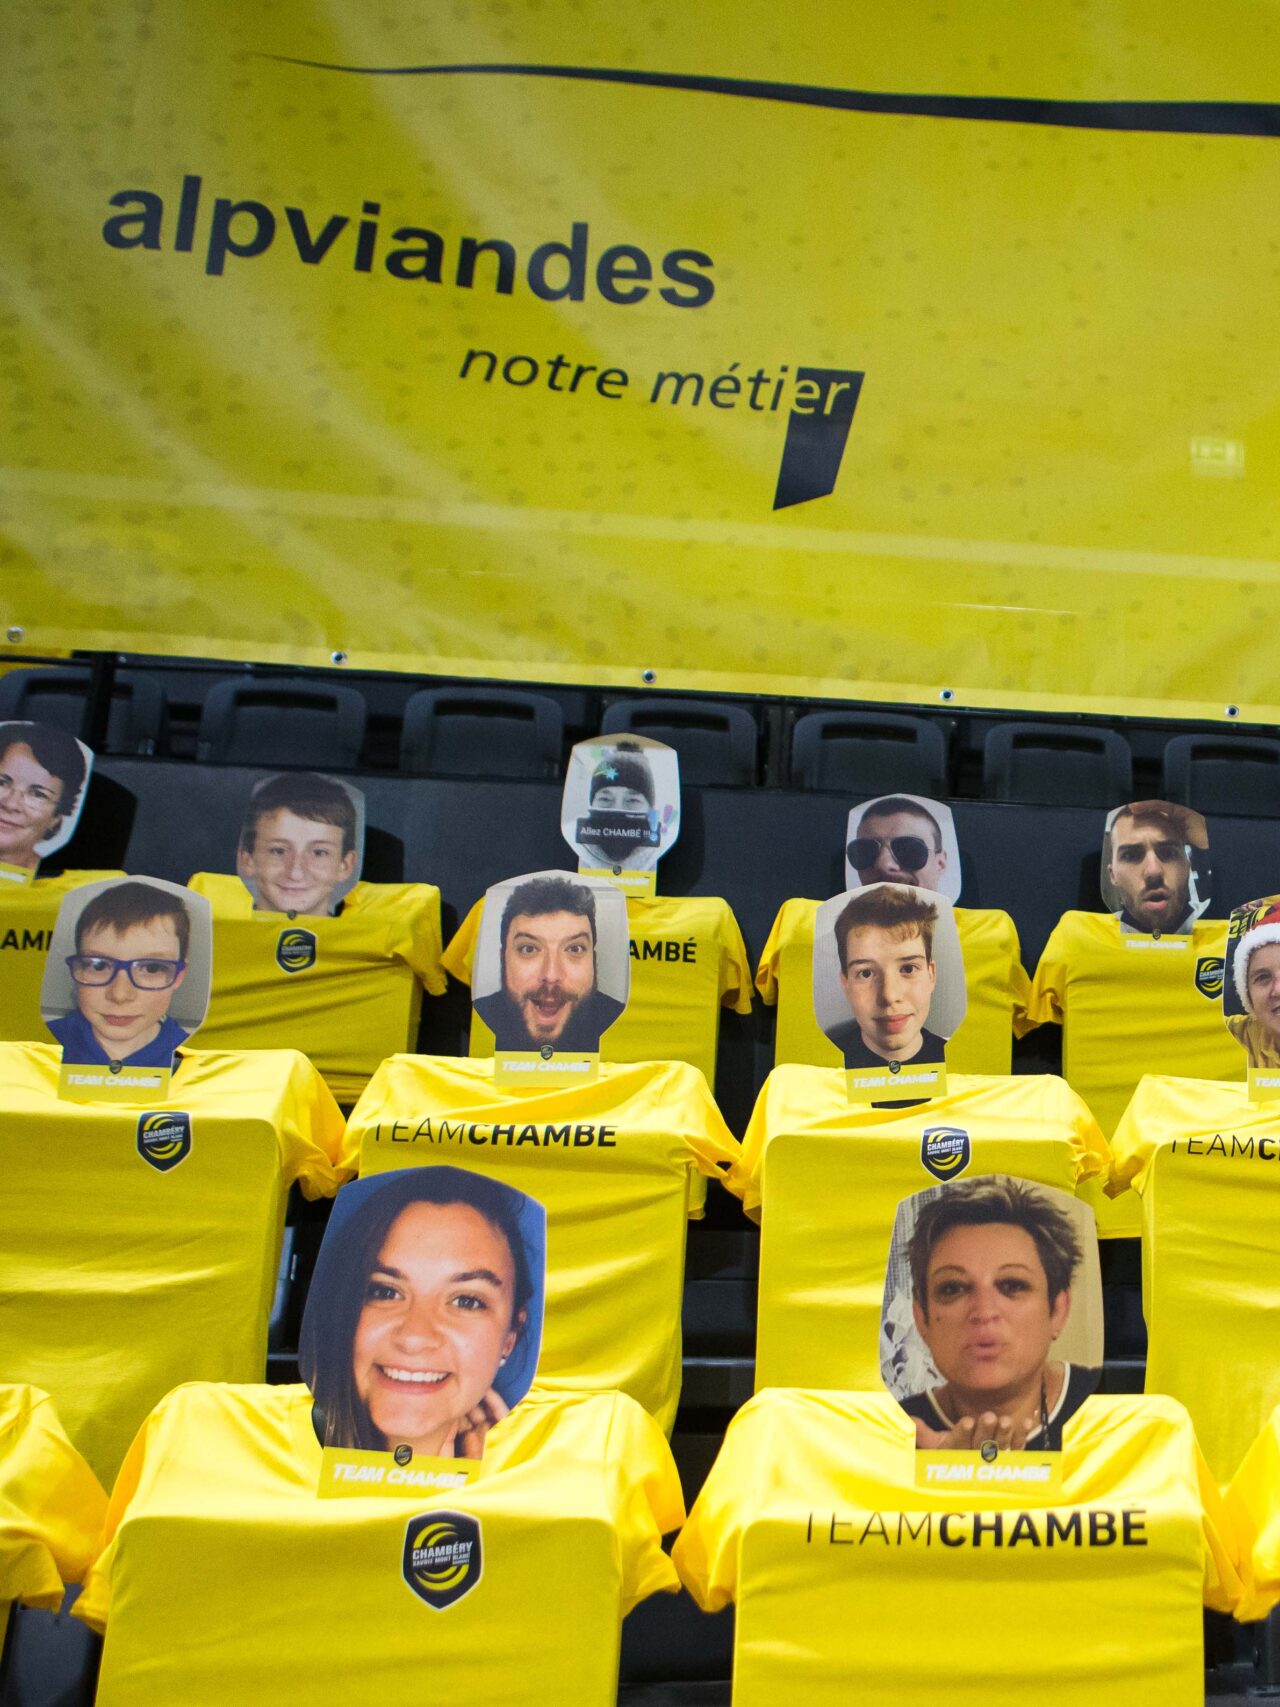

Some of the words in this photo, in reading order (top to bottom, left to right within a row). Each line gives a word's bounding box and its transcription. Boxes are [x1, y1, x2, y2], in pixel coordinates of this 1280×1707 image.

[103, 174, 716, 309] alpviandes
[458, 347, 629, 399] notre
[648, 362, 853, 416] métier
[580, 826, 601, 836] Allez
[602, 827, 641, 838] CHAMBÉ
[502, 1061, 536, 1072] TEAM
[68, 1074, 102, 1086] TEAM
[854, 1076, 887, 1088] TEAM
[332, 1463, 383, 1482] TEAM
[926, 1464, 976, 1481] TEAM
[412, 1541, 473, 1560] CHAMBÉRY
